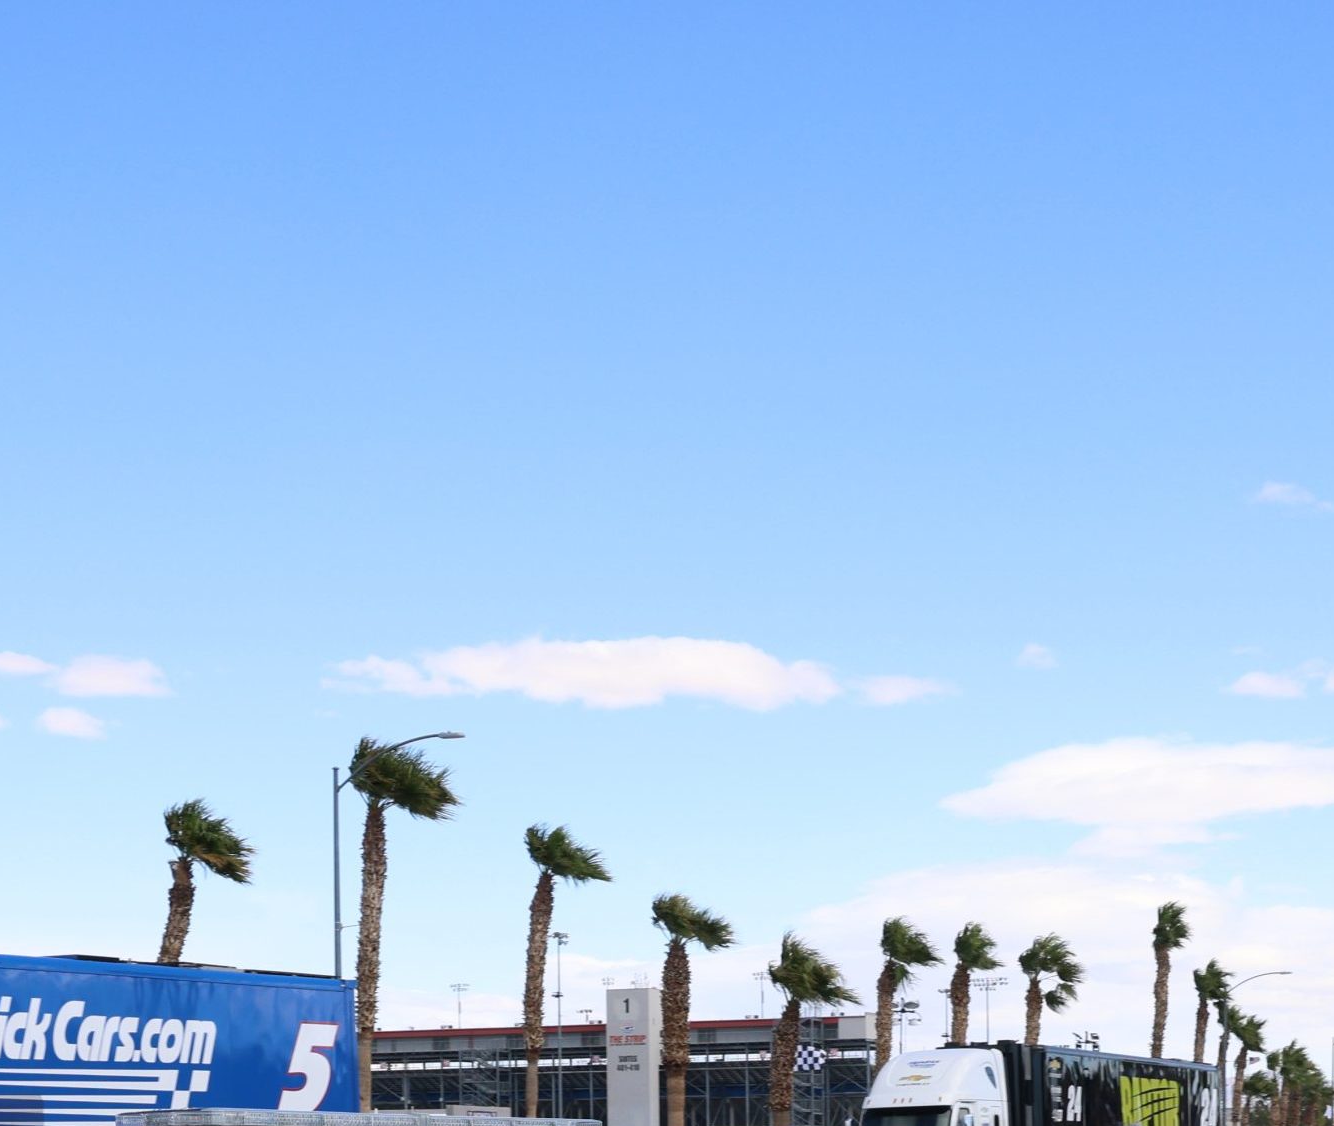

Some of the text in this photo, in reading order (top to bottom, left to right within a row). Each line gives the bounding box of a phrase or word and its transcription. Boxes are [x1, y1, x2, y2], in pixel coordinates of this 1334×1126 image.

[623, 998, 630, 1014] 1
[277, 1021, 339, 1112] 5
[1067, 1085, 1082, 1122] 24
